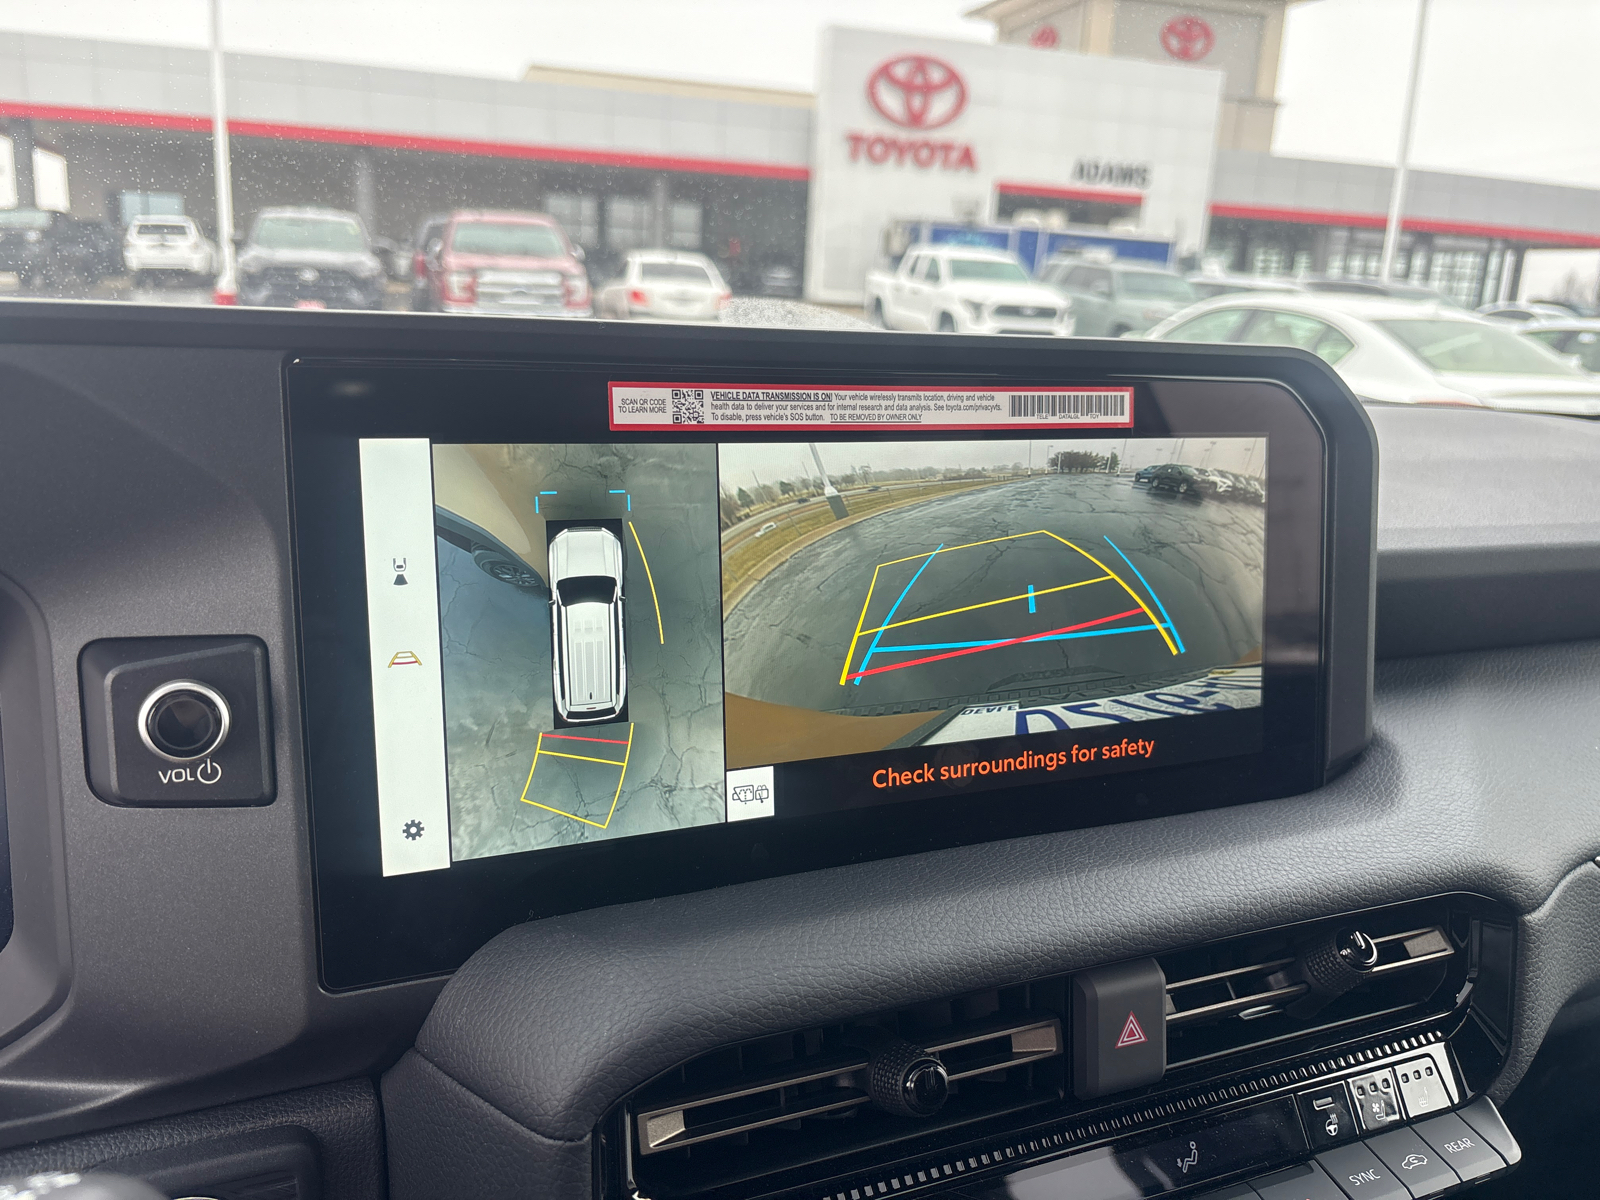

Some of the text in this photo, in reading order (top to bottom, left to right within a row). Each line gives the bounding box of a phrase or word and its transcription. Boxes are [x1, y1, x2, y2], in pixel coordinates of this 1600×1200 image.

[846, 133, 979, 171] TOYOTA
[1073, 158, 1150, 185] ADAMS
[621, 398, 667, 406] SCAN QR CODE
[710, 391, 995, 403] VEHICLE DATA TRANSMISSION IS ON! Your vehicle wirelessly transmits location, driving and vehicle
[618, 405, 667, 413] TO LEARN MORE
[711, 402, 1002, 412] health data to deliver your services and for internal research and data analysis. See toyota.com/privacyvts.
[711, 412, 922, 422] To disable, press vehicle's SOS button. TO BE REMOVED BY OWNER ONLY
[872, 738, 1155, 789] Check surroundings for safety
[158, 767, 195, 784] VOL
[1444, 1137, 1476, 1154] REAR
[1349, 1168, 1381, 1186] SYNC
